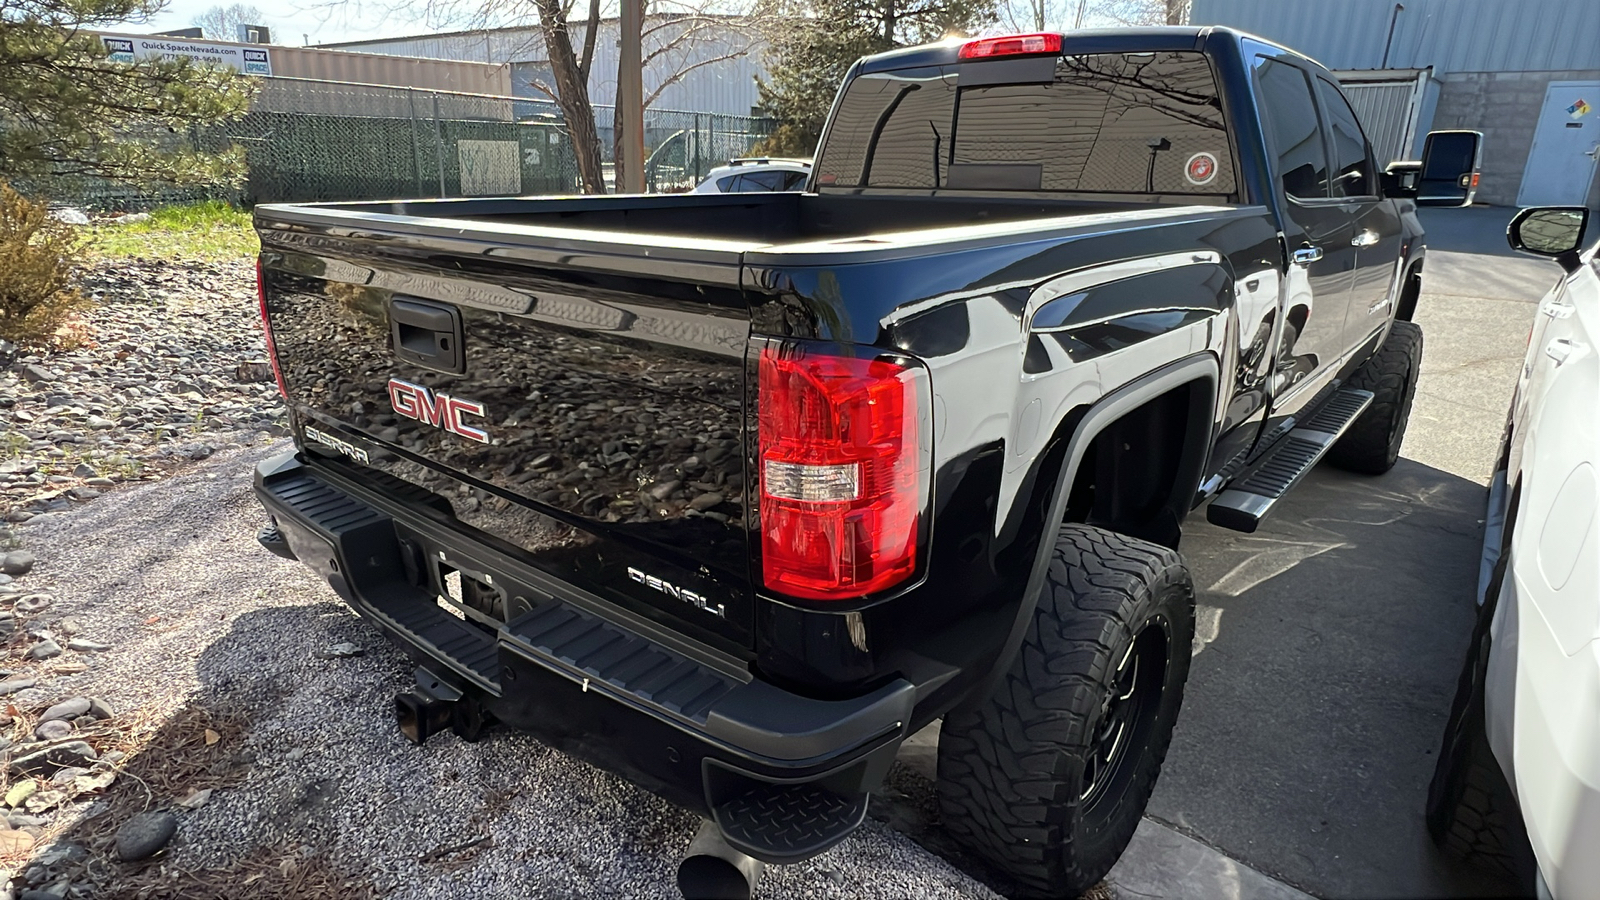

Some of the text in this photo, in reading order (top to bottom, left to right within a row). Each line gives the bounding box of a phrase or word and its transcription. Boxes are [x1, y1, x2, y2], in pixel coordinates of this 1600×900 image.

[109, 54, 133, 63] SPACE
[245, 51, 265, 61] QUICK
[247, 63, 267, 71] SPACE
[388, 378, 491, 444] GMC
[305, 425, 370, 465] SIERRA
[627, 566, 725, 618] DENALI
